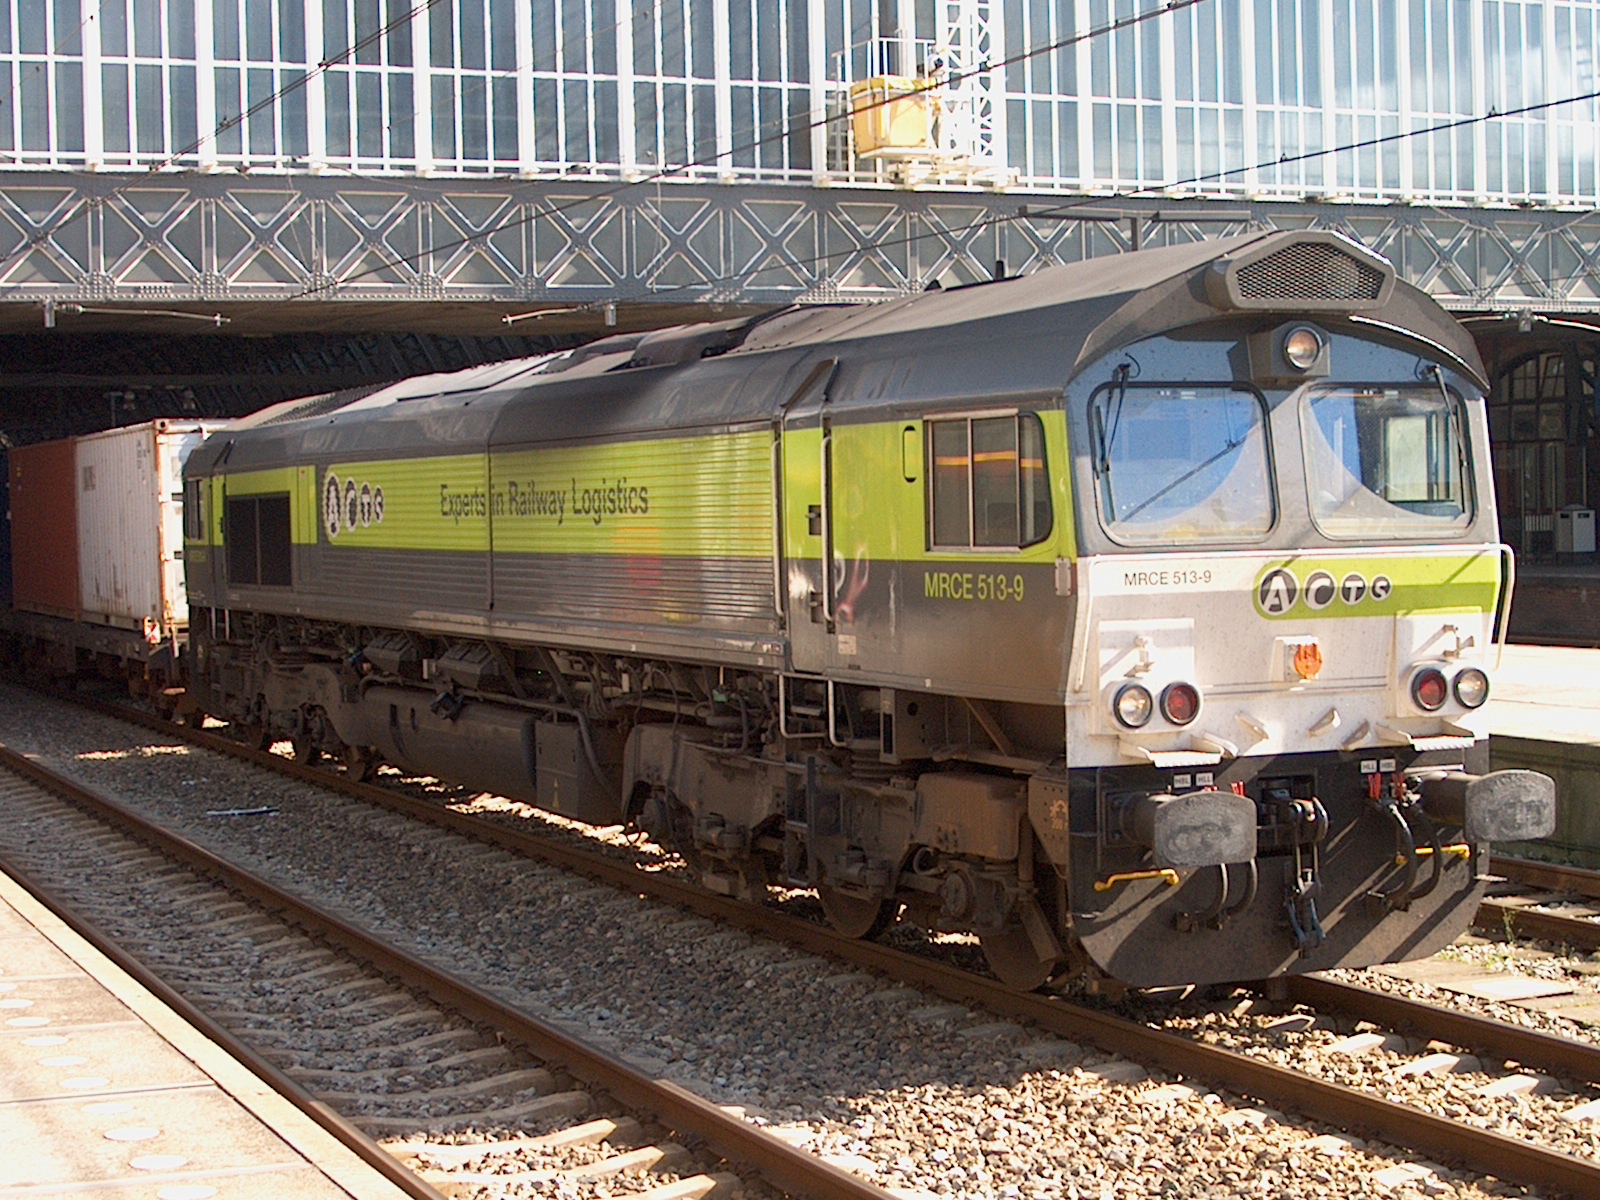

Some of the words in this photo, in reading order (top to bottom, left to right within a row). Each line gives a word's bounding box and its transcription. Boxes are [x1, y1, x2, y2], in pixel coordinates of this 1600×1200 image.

[324, 474, 385, 537] ACTS
[440, 484, 486, 525] Experts
[491, 483, 504, 515] in
[508, 480, 566, 525] Railway
[571, 477, 649, 525] Logistics
[924, 571, 974, 600] MRCE
[977, 573, 1024, 602] 513-9
[1124, 571, 1169, 586] MRCE
[1173, 570, 1212, 585] 513-9
[1259, 568, 1391, 615] ACTS
